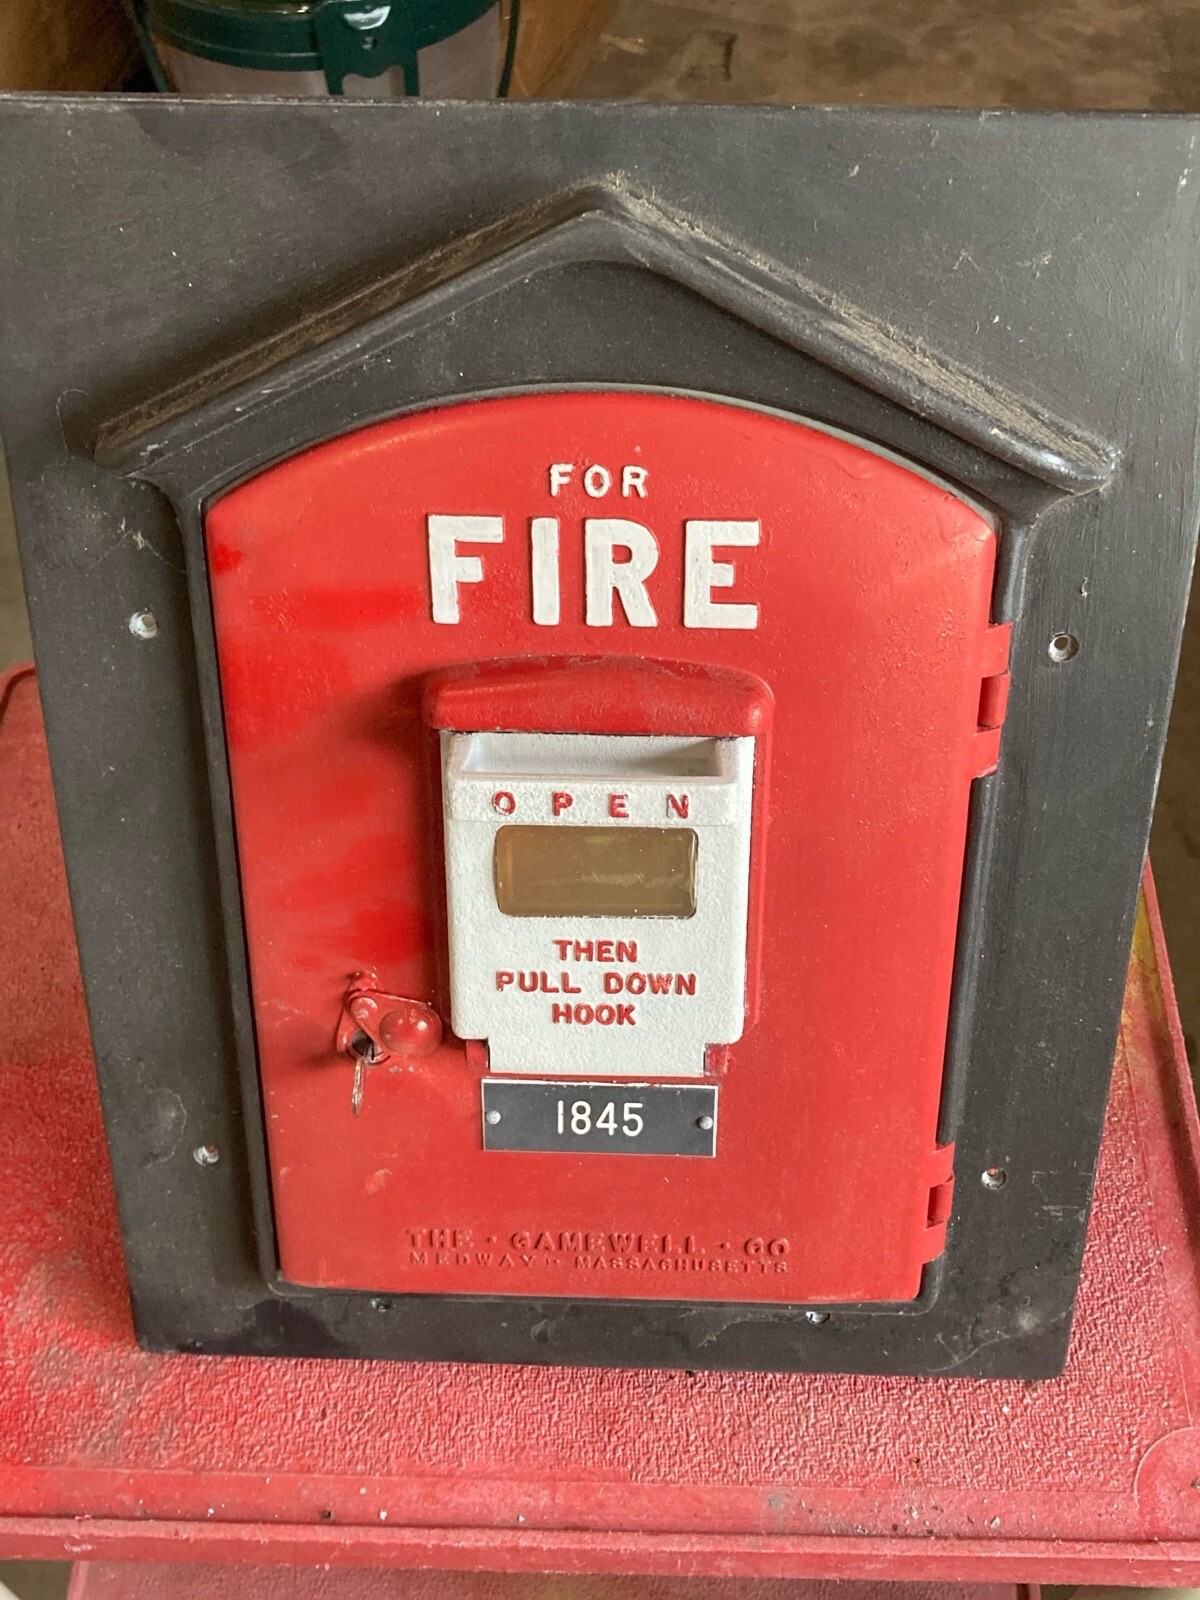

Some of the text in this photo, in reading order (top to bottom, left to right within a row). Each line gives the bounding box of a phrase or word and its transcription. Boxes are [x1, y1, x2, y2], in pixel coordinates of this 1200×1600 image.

[549, 463, 648, 498] FOR
[427, 513, 761, 630] FIRE
[492, 790, 690, 819] OPEN
[553, 939, 638, 962] THEN
[495, 971, 697, 996] PULL DOWN
[552, 1003, 637, 1026] HOOK
[556, 1099, 644, 1137] 1845
[406, 1228, 474, 1249] THE
[510, 1231, 705, 1255] GAMEWELL
[574, 1254, 789, 1274] MASSACHUSETTS
